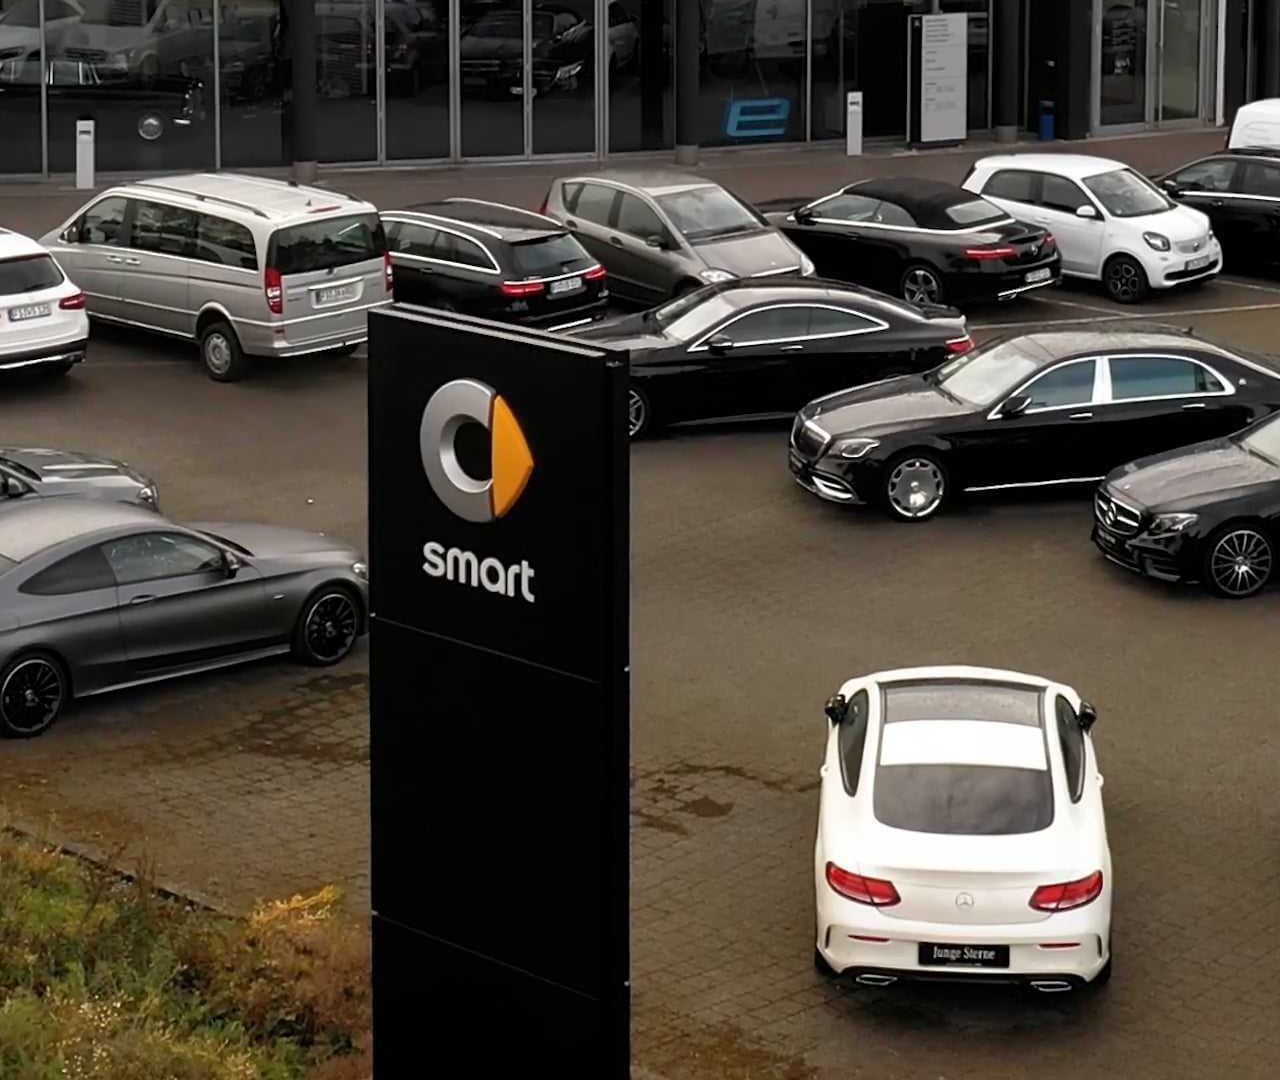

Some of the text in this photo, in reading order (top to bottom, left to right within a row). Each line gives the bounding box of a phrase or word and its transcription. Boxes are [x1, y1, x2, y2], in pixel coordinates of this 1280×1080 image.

[422, 541, 535, 603] smart
[933, 945, 996, 961] Junge Sterne
